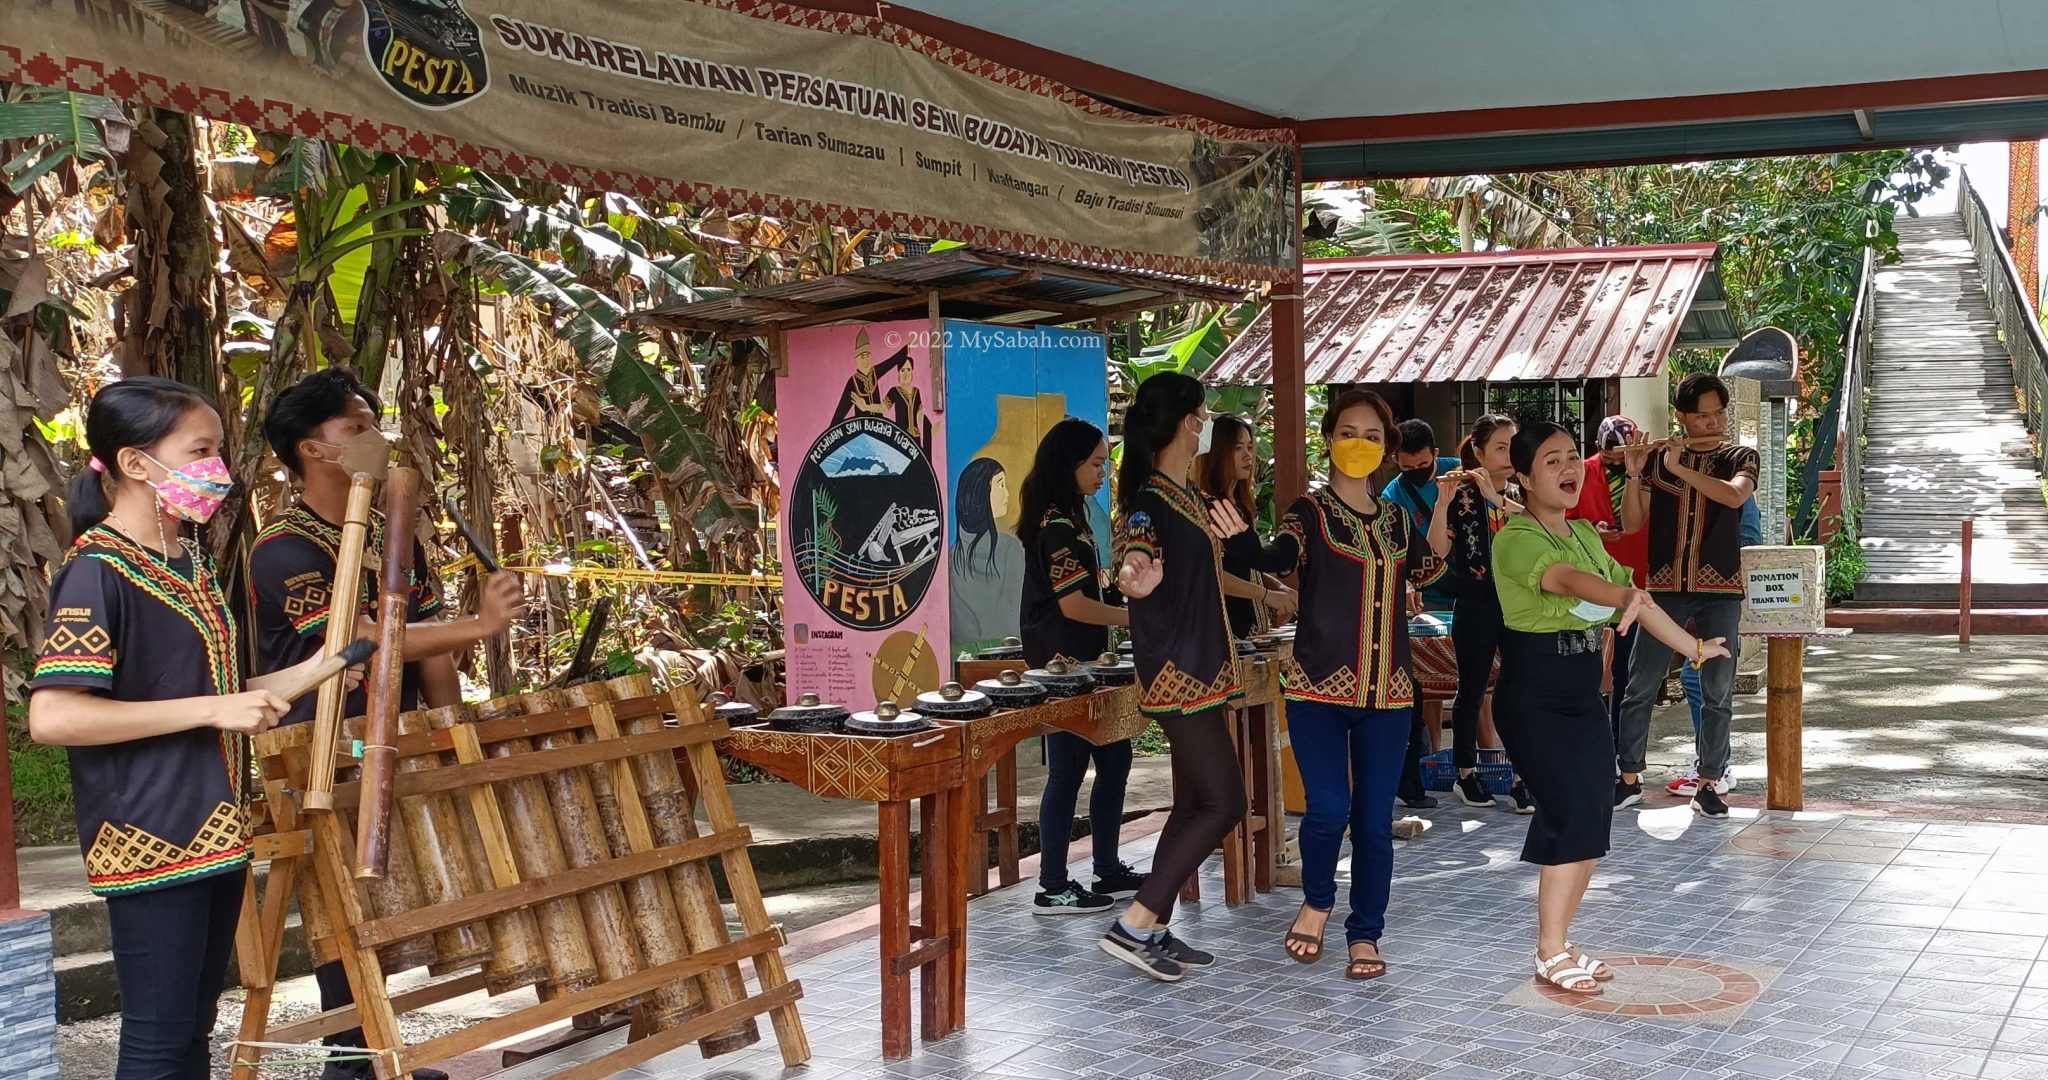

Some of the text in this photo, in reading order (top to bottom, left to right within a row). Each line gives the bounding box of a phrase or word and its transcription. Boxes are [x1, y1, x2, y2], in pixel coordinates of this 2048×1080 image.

[384, 37, 476, 96] PESTA
[492, 17, 1191, 193] SUKARELAWAN PERSATUAN SENI BUDAYA TUARAN (PESTA)
[508, 73, 1185, 220] Muzik Tradisi Bambu Tarian Sumazau Sumpit Kraftangan Baju Tradisi Sinunsui
[1750, 572, 1799, 582] DONATION
[1765, 583, 1785, 592] BOX
[822, 579, 909, 622] PESTA
[1751, 595, 1790, 604] THANK YOU
[811, 630, 843, 640] INSTAGRAM
